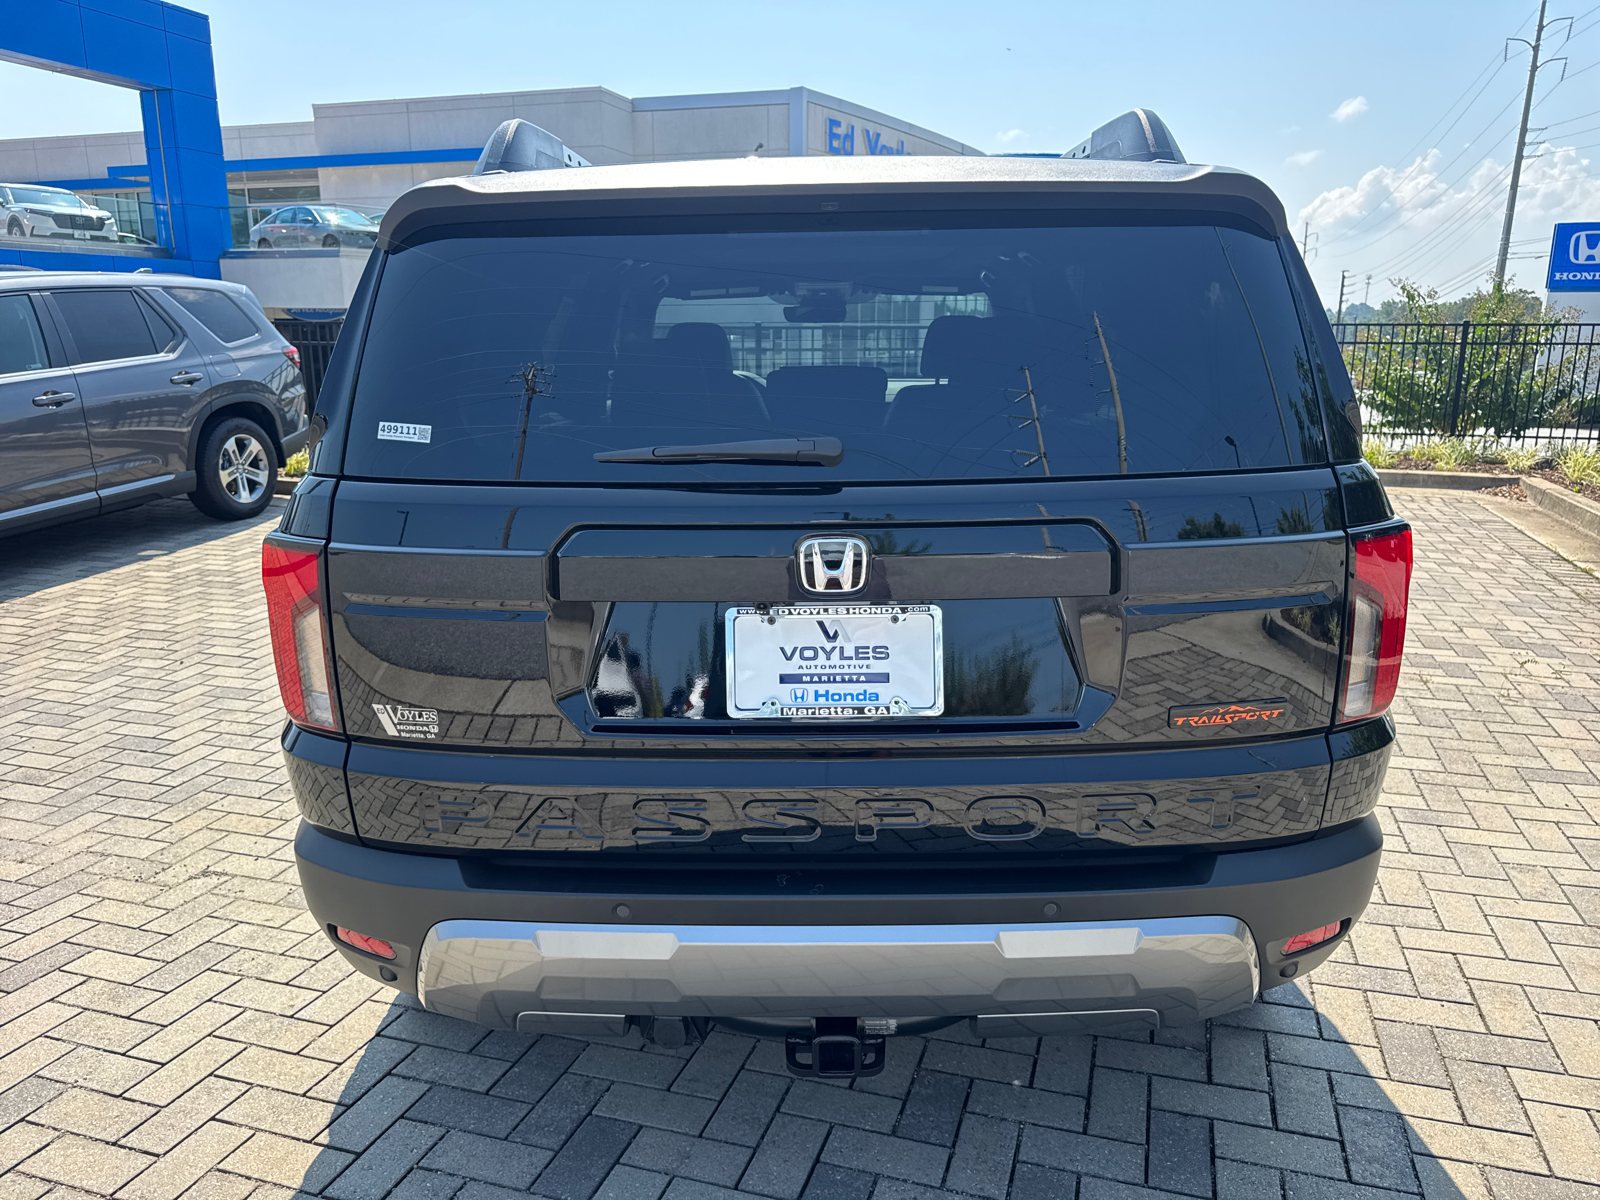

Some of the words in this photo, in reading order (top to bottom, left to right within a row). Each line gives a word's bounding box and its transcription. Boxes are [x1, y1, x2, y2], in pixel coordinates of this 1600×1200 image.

[828, 118, 855, 156] Ed
[380, 424, 417, 435] 499111
[779, 645, 890, 661] VOYLES
[814, 689, 880, 702] Honda
[385, 704, 437, 724] VOYLES
[783, 706, 858, 716] Marietta,
[864, 706, 888, 716] GA
[1174, 709, 1284, 727] TRAILSPORT
[396, 724, 430, 732] HONDA
[400, 731, 426, 739] Marietta,
[418, 785, 1263, 843] PASSPORT
